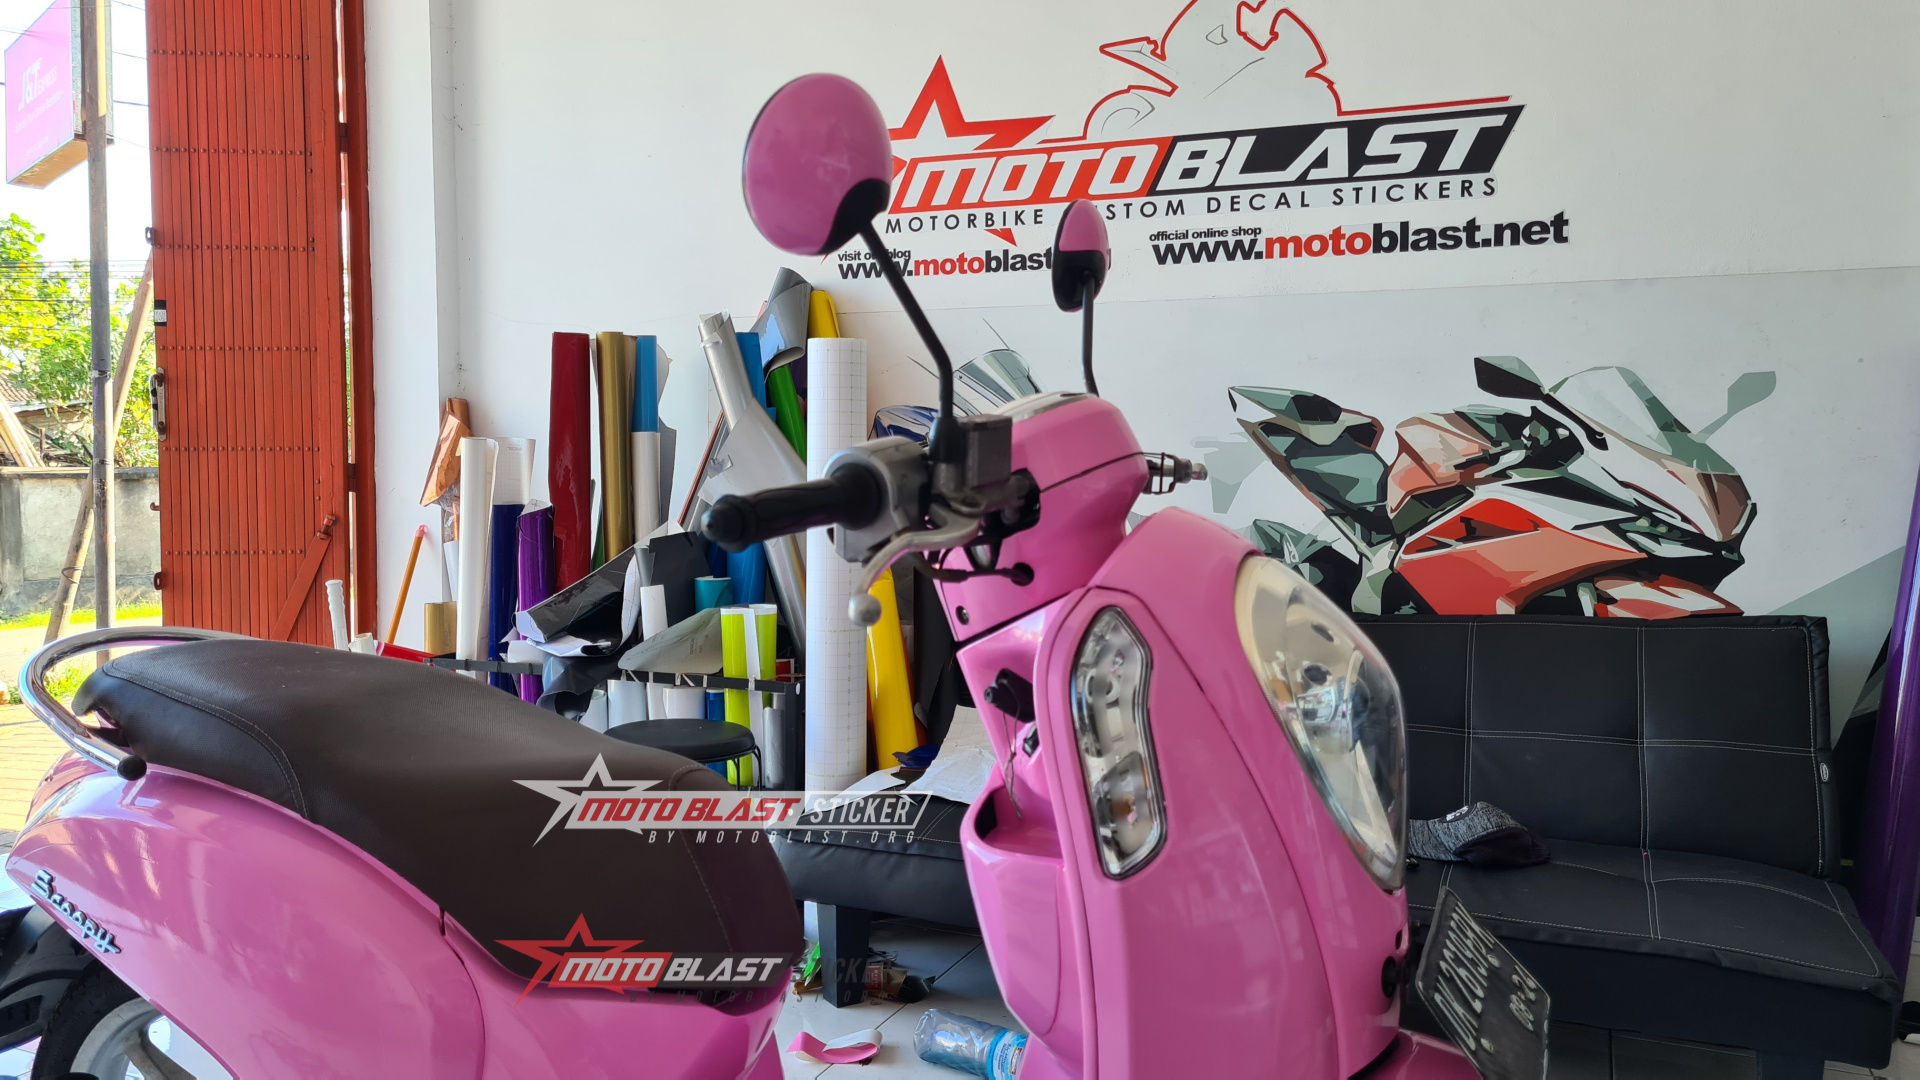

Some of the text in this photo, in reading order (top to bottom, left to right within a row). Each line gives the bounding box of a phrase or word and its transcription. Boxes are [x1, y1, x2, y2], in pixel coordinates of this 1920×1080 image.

[885, 178, 1496, 234] MOTORBIKE STOM DECAL STICKERS
[1149, 226, 1262, 241] official online shop
[1151, 210, 1570, 265] www.motoblast.net
[838, 251, 861, 262] visit
